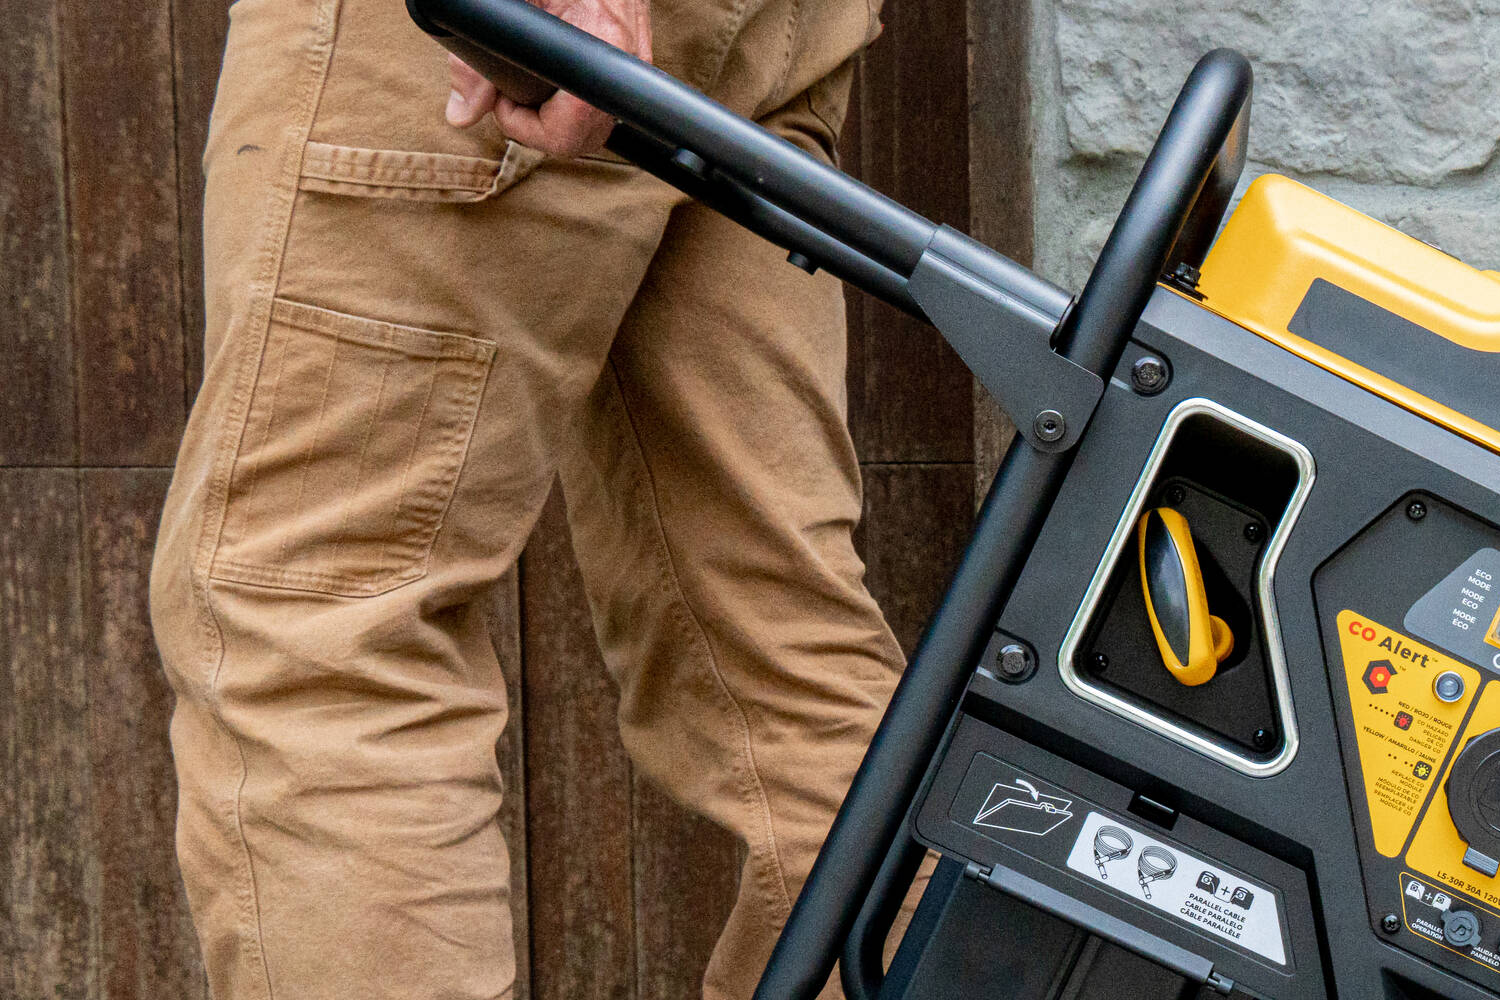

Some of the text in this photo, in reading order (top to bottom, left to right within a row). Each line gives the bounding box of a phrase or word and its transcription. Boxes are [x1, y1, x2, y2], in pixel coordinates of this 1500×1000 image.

[1475, 569, 1492, 581] ECO
[1468, 576, 1491, 591] MODE
[1461, 588, 1485, 602] MODE
[1461, 598, 1478, 609] ECO
[1452, 608, 1476, 623] MODE
[1348, 621, 1376, 641] CO
[1378, 635, 1430, 668] Alert
[1398, 701, 1410, 710] RED
[1414, 709, 1429, 719] ROJO
[1433, 718, 1452, 729] ROUGE
[1362, 726, 1385, 739] YELLOW
[1388, 738, 1415, 753] AMARILLO
[1418, 752, 1436, 763] JAUNE
[1436, 871, 1465, 888] L5-30R
[1465, 884, 1482, 896] 30A
[1185, 900, 1243, 931] CABLE PARALELO
[1189, 893, 1246, 923] PARALLEL CABLE
[1411, 923, 1443, 940] OPERATION
[1416, 918, 1444, 934] PARALLEL
[1470, 950, 1500, 966] PARALELO
